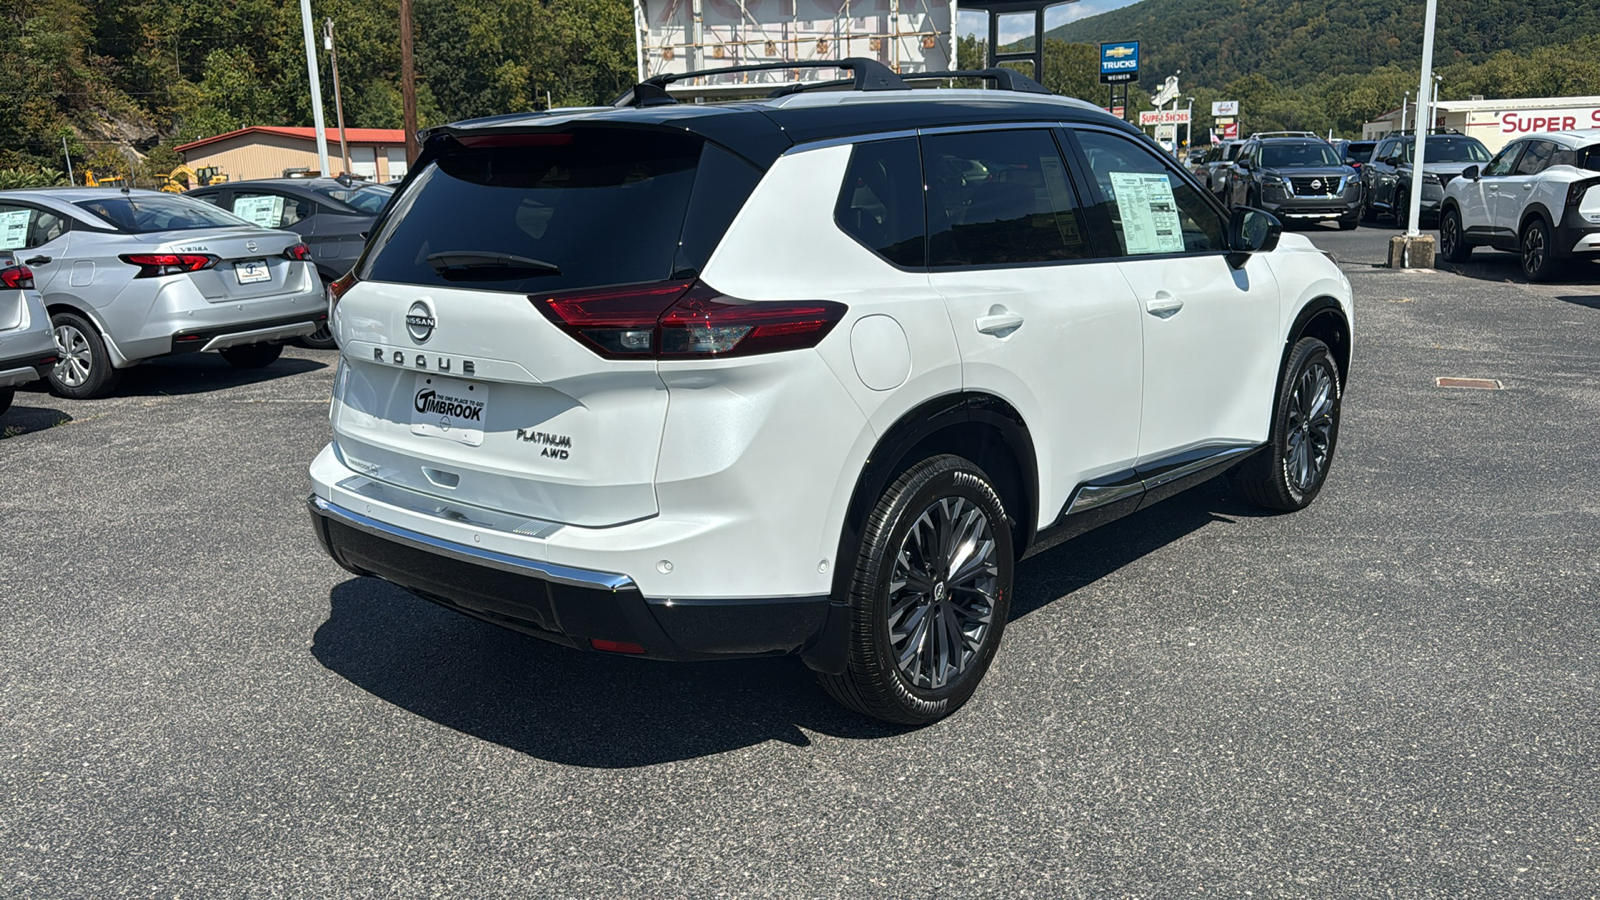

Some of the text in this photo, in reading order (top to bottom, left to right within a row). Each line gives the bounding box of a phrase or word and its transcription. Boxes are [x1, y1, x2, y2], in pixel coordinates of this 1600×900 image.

[1103, 60, 1136, 69] TRUCKS
[1142, 113, 1188, 122] SUPER SHOES
[1502, 112, 1577, 133] SUPER
[407, 316, 434, 326] NISSAN
[374, 348, 475, 374] ROGUE
[414, 387, 483, 421] TIMBROOK
[453, 397, 469, 405] PLACE
[516, 428, 572, 449] PLATINUM
[540, 447, 569, 460] AWD
[952, 471, 1008, 524] BRIDGESTONE
[887, 669, 948, 714] BRIDGESTONE
